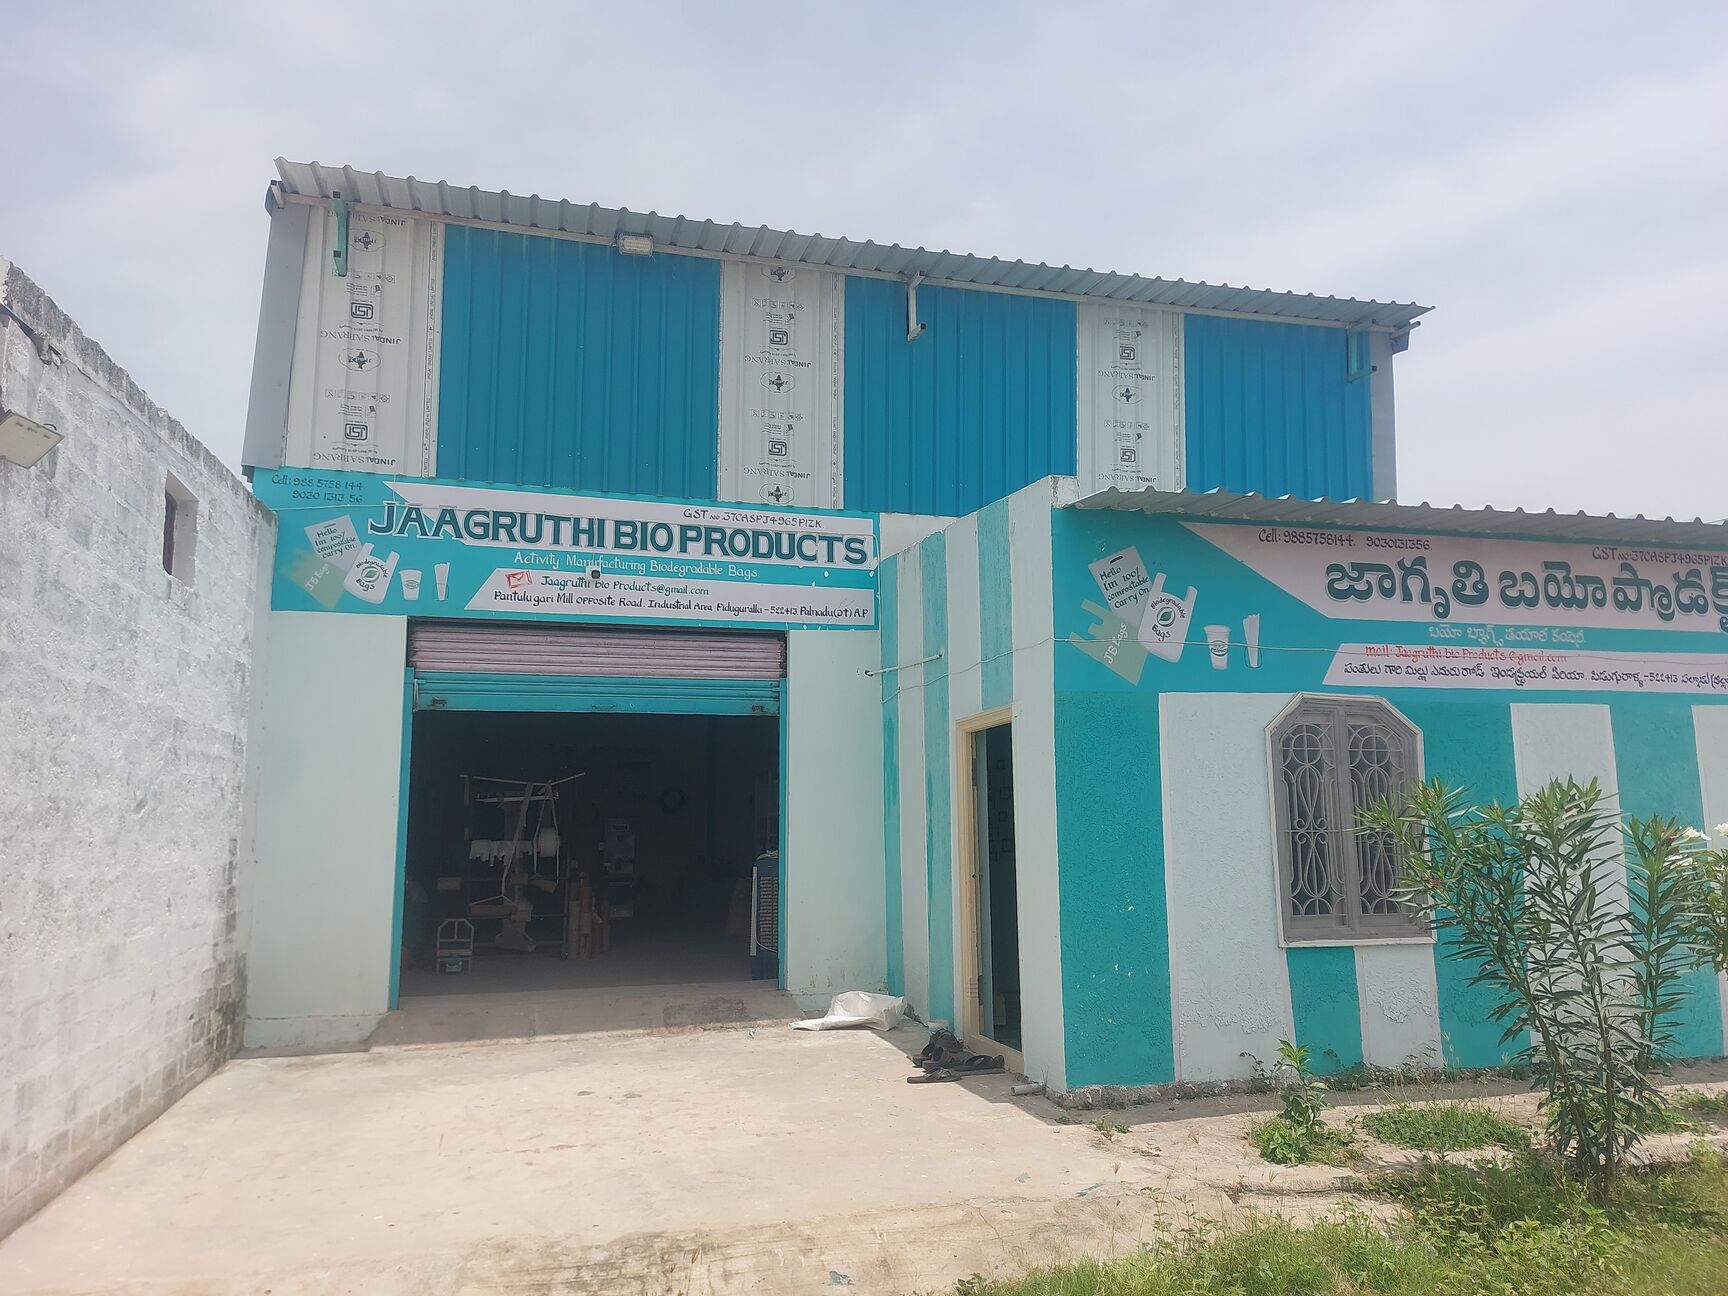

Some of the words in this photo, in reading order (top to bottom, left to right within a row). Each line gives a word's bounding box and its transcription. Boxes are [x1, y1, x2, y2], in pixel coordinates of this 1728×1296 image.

[292, 490, 320, 500] 9030
[683, 508, 709, 520] GST
[316, 528, 338, 539] Hello
[367, 500, 607, 549] JAAGRUTHI
[612, 519, 674, 552] BIO
[678, 522, 868, 566] PRODUCTS
[1258, 528, 1282, 543] Cell:
[1591, 546, 1618, 561] GST
[514, 551, 560, 570] Activity
[650, 559, 723, 578] Biodegradable
[728, 564, 758, 581] Bags
[1099, 567, 1122, 582] Hello
[541, 575, 591, 591] Jaagruthi
[556, 592, 574, 604] Mill
[648, 598, 693, 611] Industrial
[694, 602, 713, 612] Area
[1150, 596, 1187, 619] Biodegradable
[1151, 624, 1172, 642] Bags
